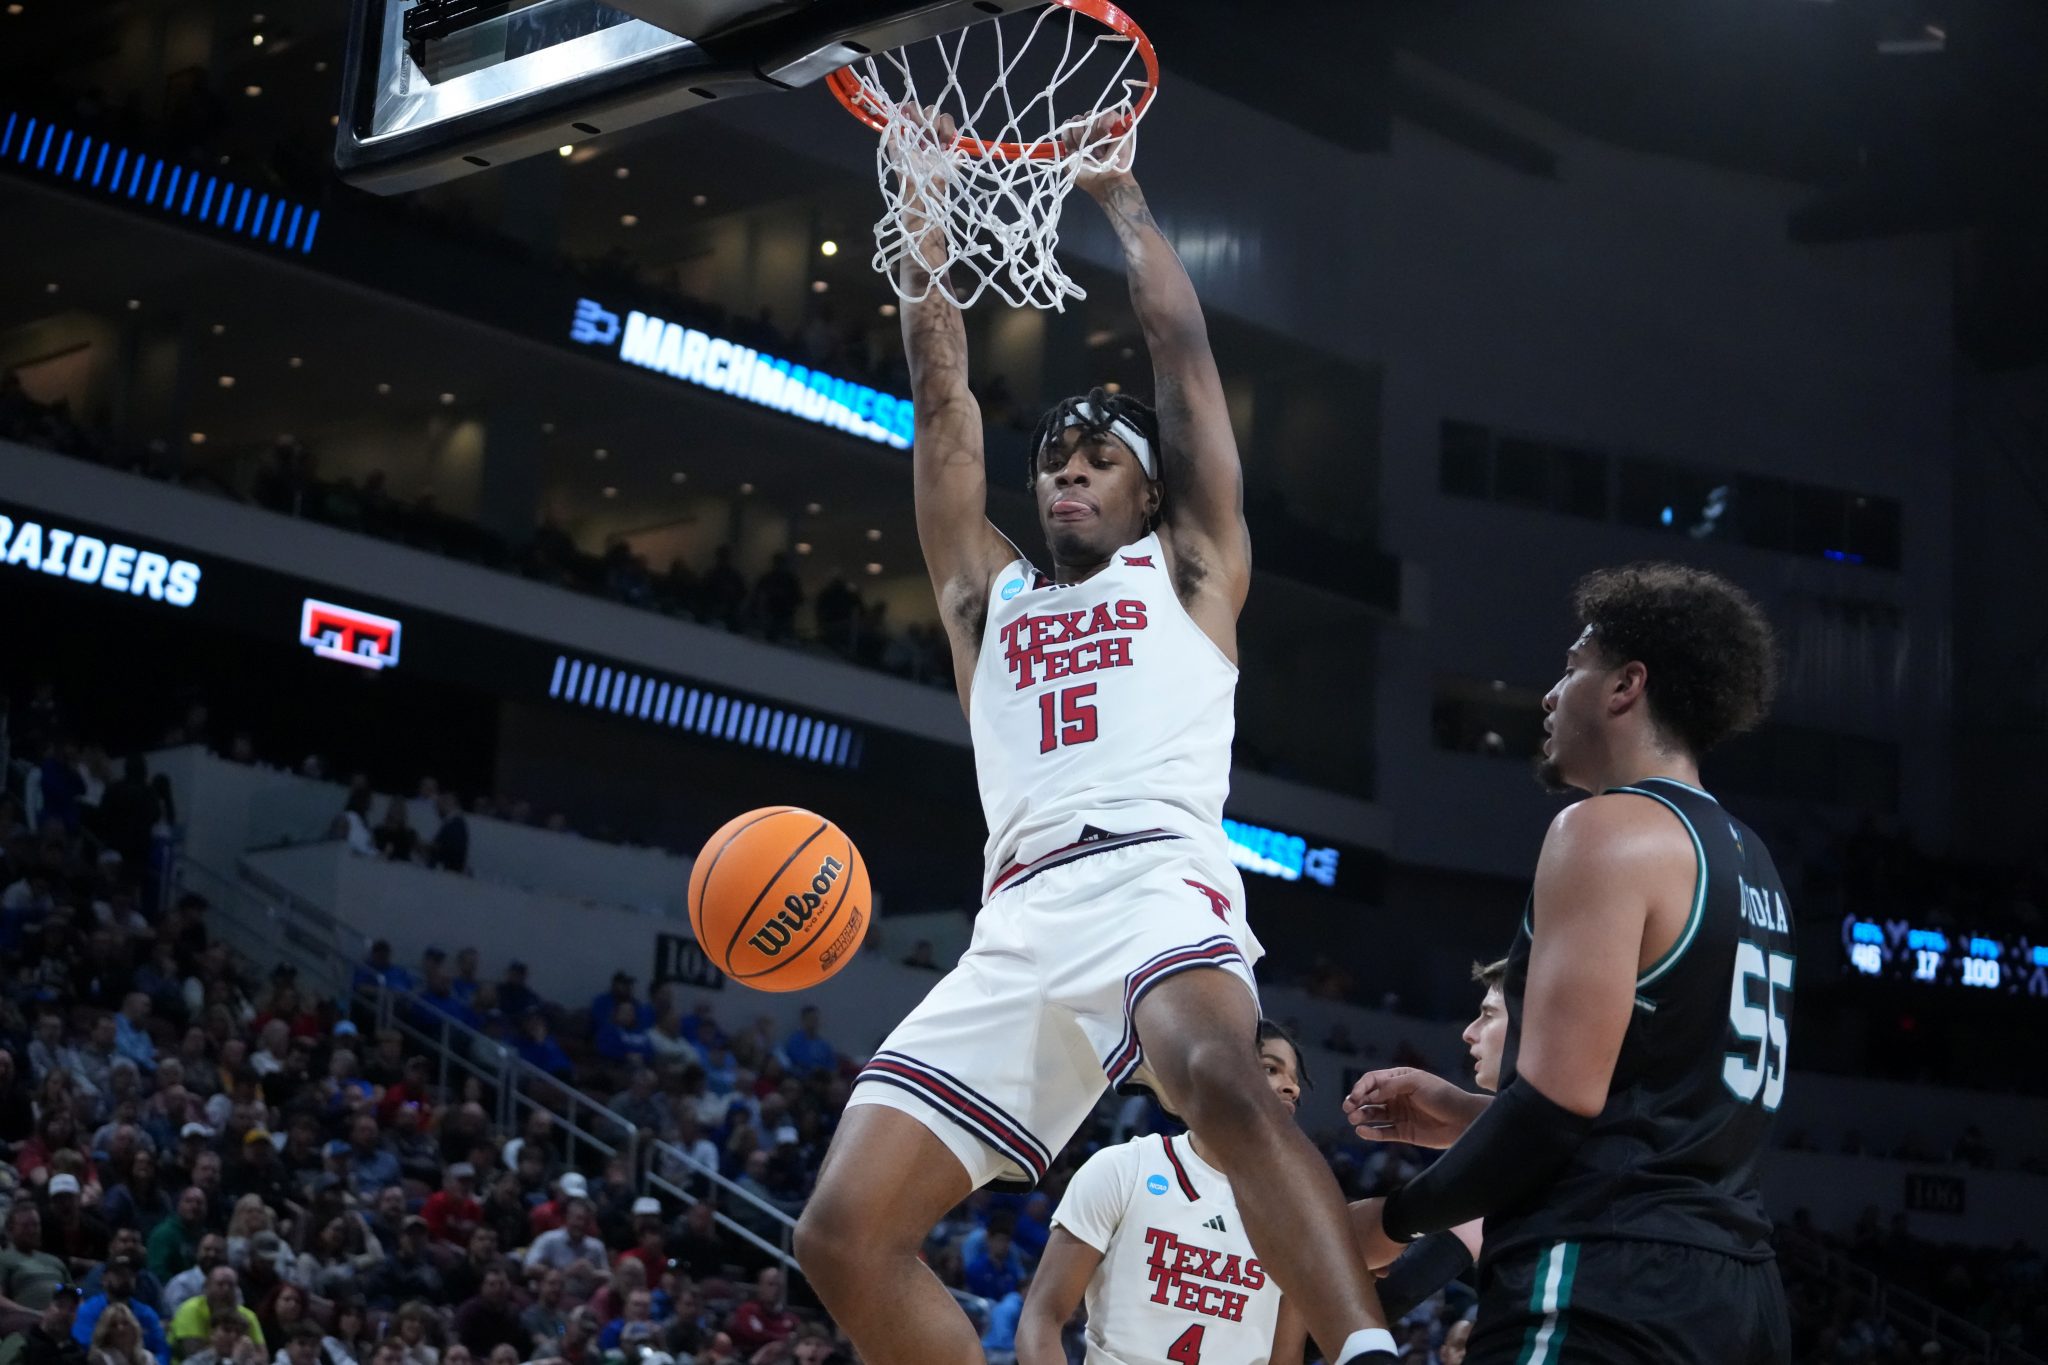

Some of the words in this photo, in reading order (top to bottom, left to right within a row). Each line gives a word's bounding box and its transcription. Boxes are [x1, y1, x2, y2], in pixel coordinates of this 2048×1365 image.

[1000, 600, 1148, 660] TEXAS
[1009, 637, 1134, 691] TECH
[1039, 682, 1098, 755] 15
[748, 855, 844, 957] Wilson
[1915, 950, 1939, 979] 17
[1962, 957, 2000, 988] 100
[1721, 938, 1797, 1113] 55
[1145, 1227, 1265, 1290] TEXAS
[1148, 1264, 1249, 1322] TECH
[1167, 1323, 1206, 1365] 4
